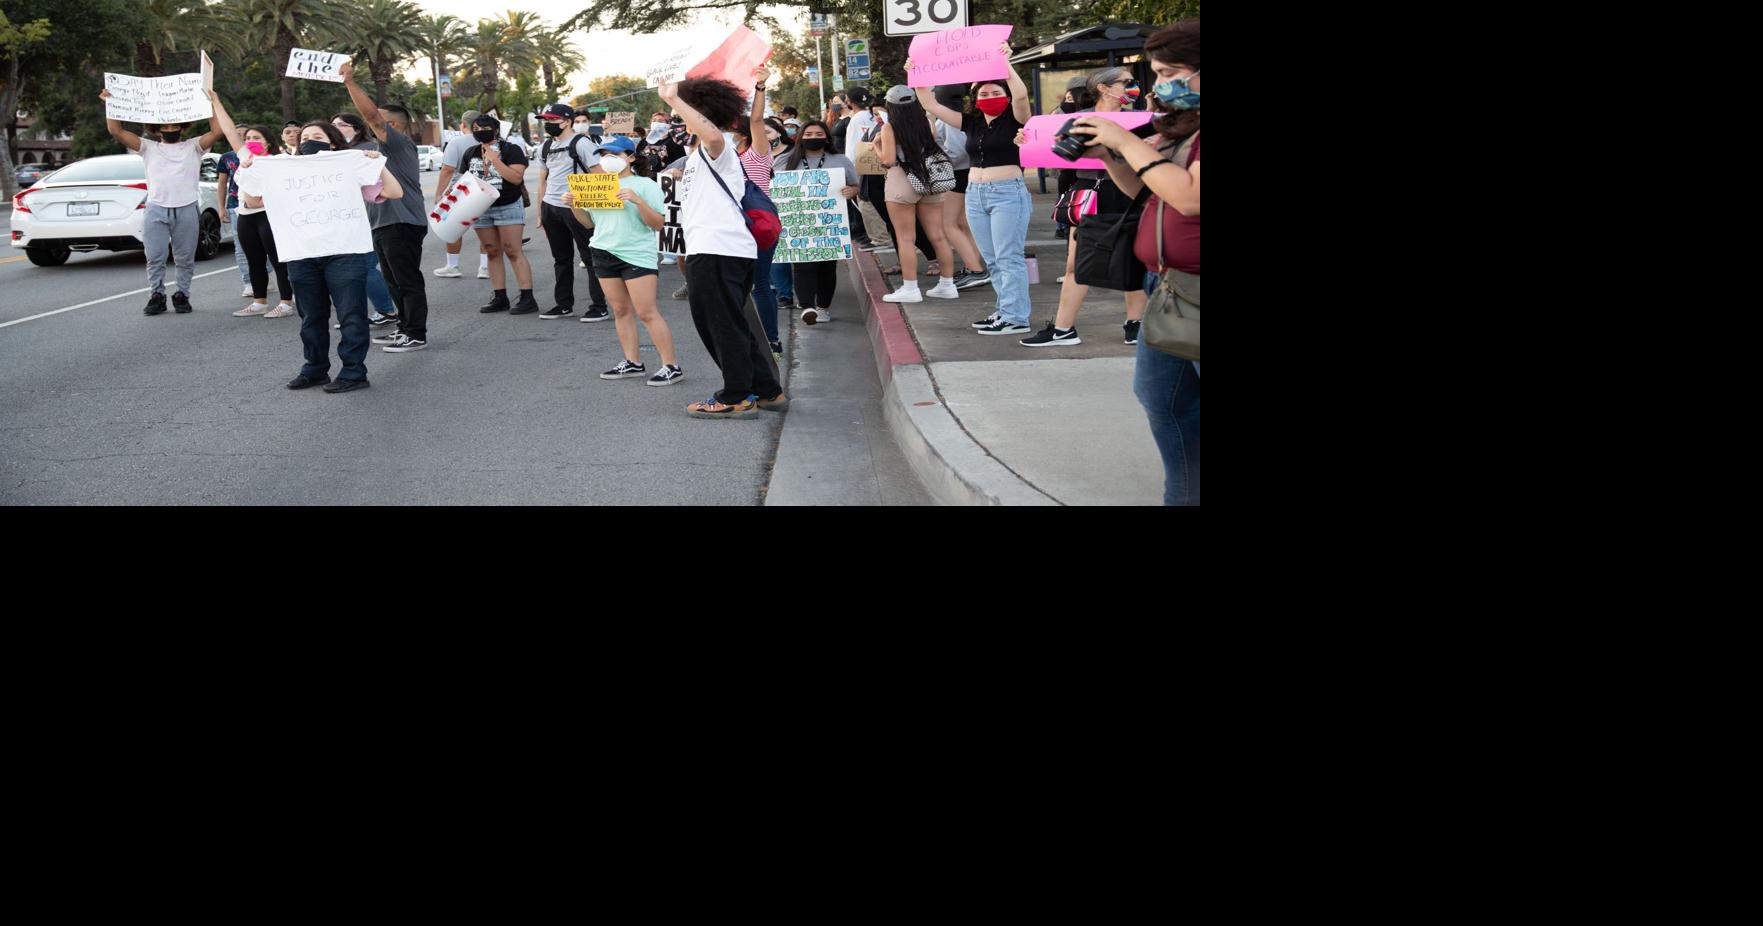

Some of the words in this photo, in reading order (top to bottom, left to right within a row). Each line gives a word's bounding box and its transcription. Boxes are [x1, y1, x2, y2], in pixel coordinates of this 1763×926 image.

[894, 0, 958, 26] 30
[937, 27, 981, 45] HOLD
[934, 42, 969, 57] COPS
[912, 51, 991, 76] ACCOUNTABLE
[284, 173, 344, 191] JUSTICE
[298, 190, 340, 203] FOR
[289, 207, 363, 228] GEORGE
[659, 227, 687, 254] MA
